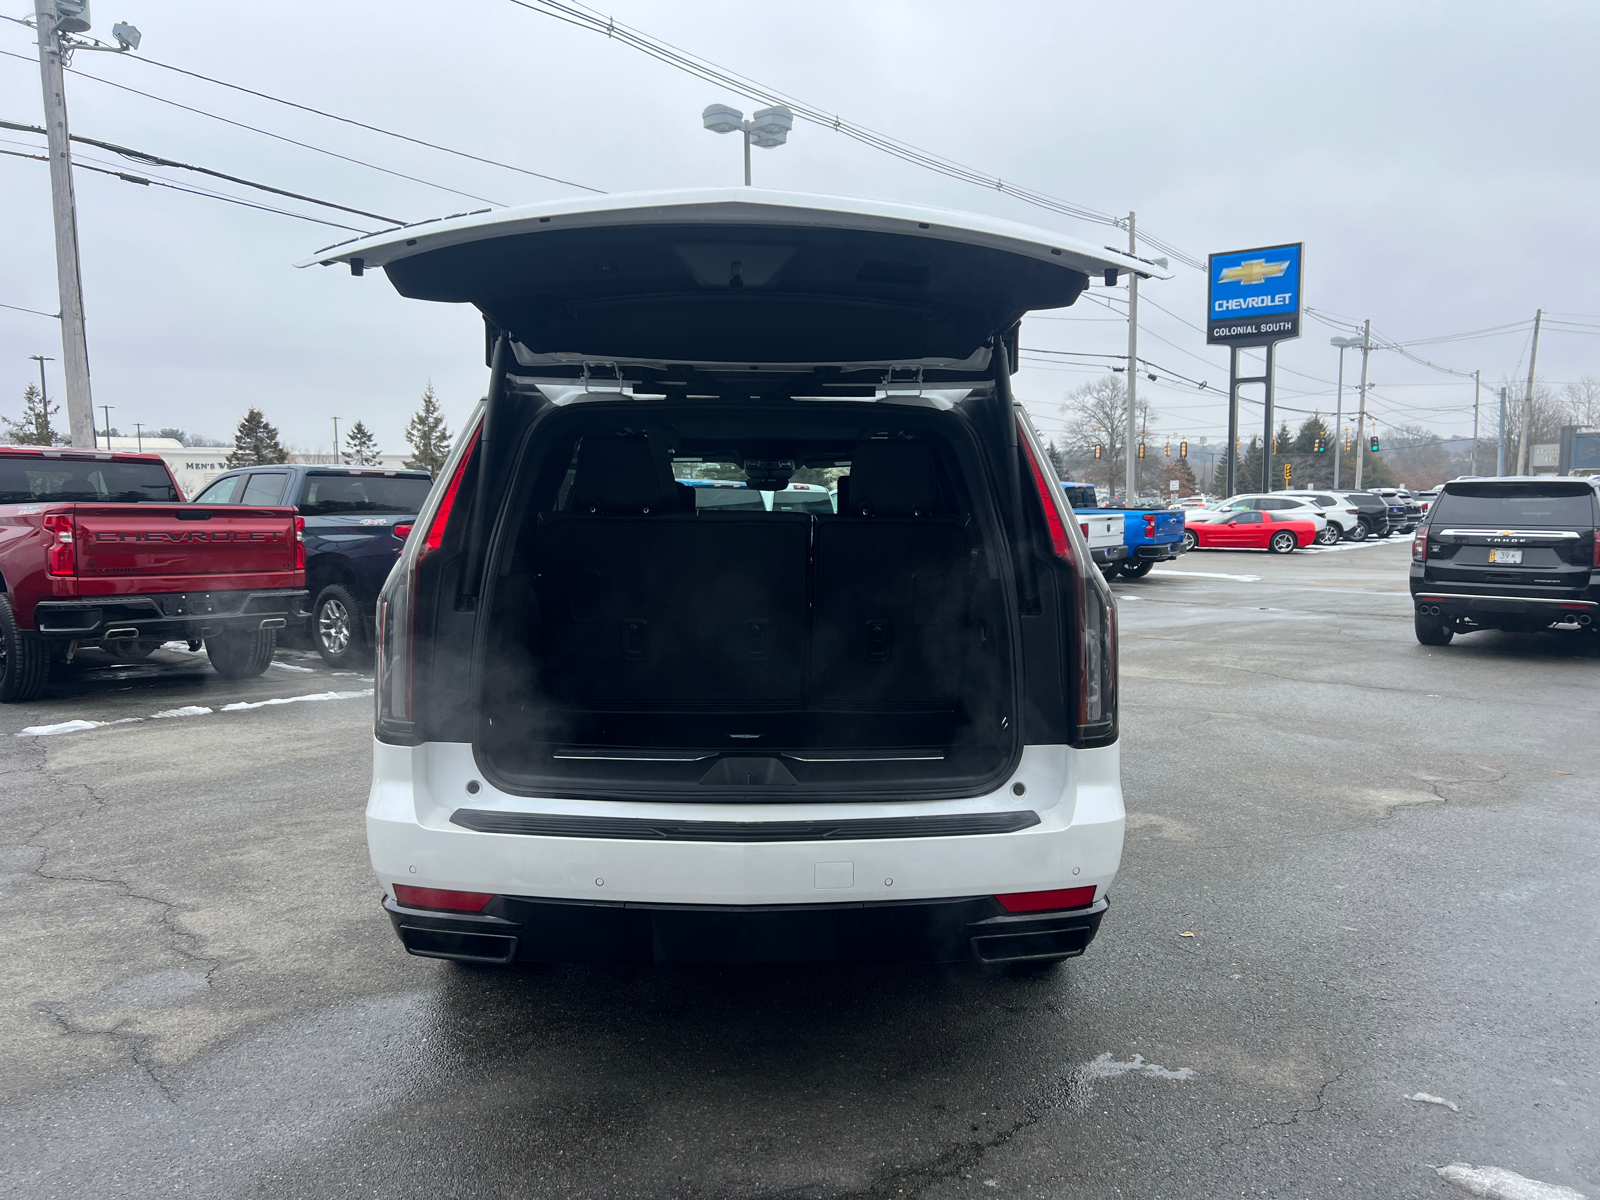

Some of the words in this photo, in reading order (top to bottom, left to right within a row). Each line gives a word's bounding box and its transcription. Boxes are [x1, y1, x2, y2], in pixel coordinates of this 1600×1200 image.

[1214, 293, 1292, 311] CHEVROLET
[1213, 325, 1258, 337] COLONIAL
[1260, 321, 1292, 333] SOUTH
[185, 462, 216, 470] MEN'S
[95, 531, 284, 543] CHEVROLET
